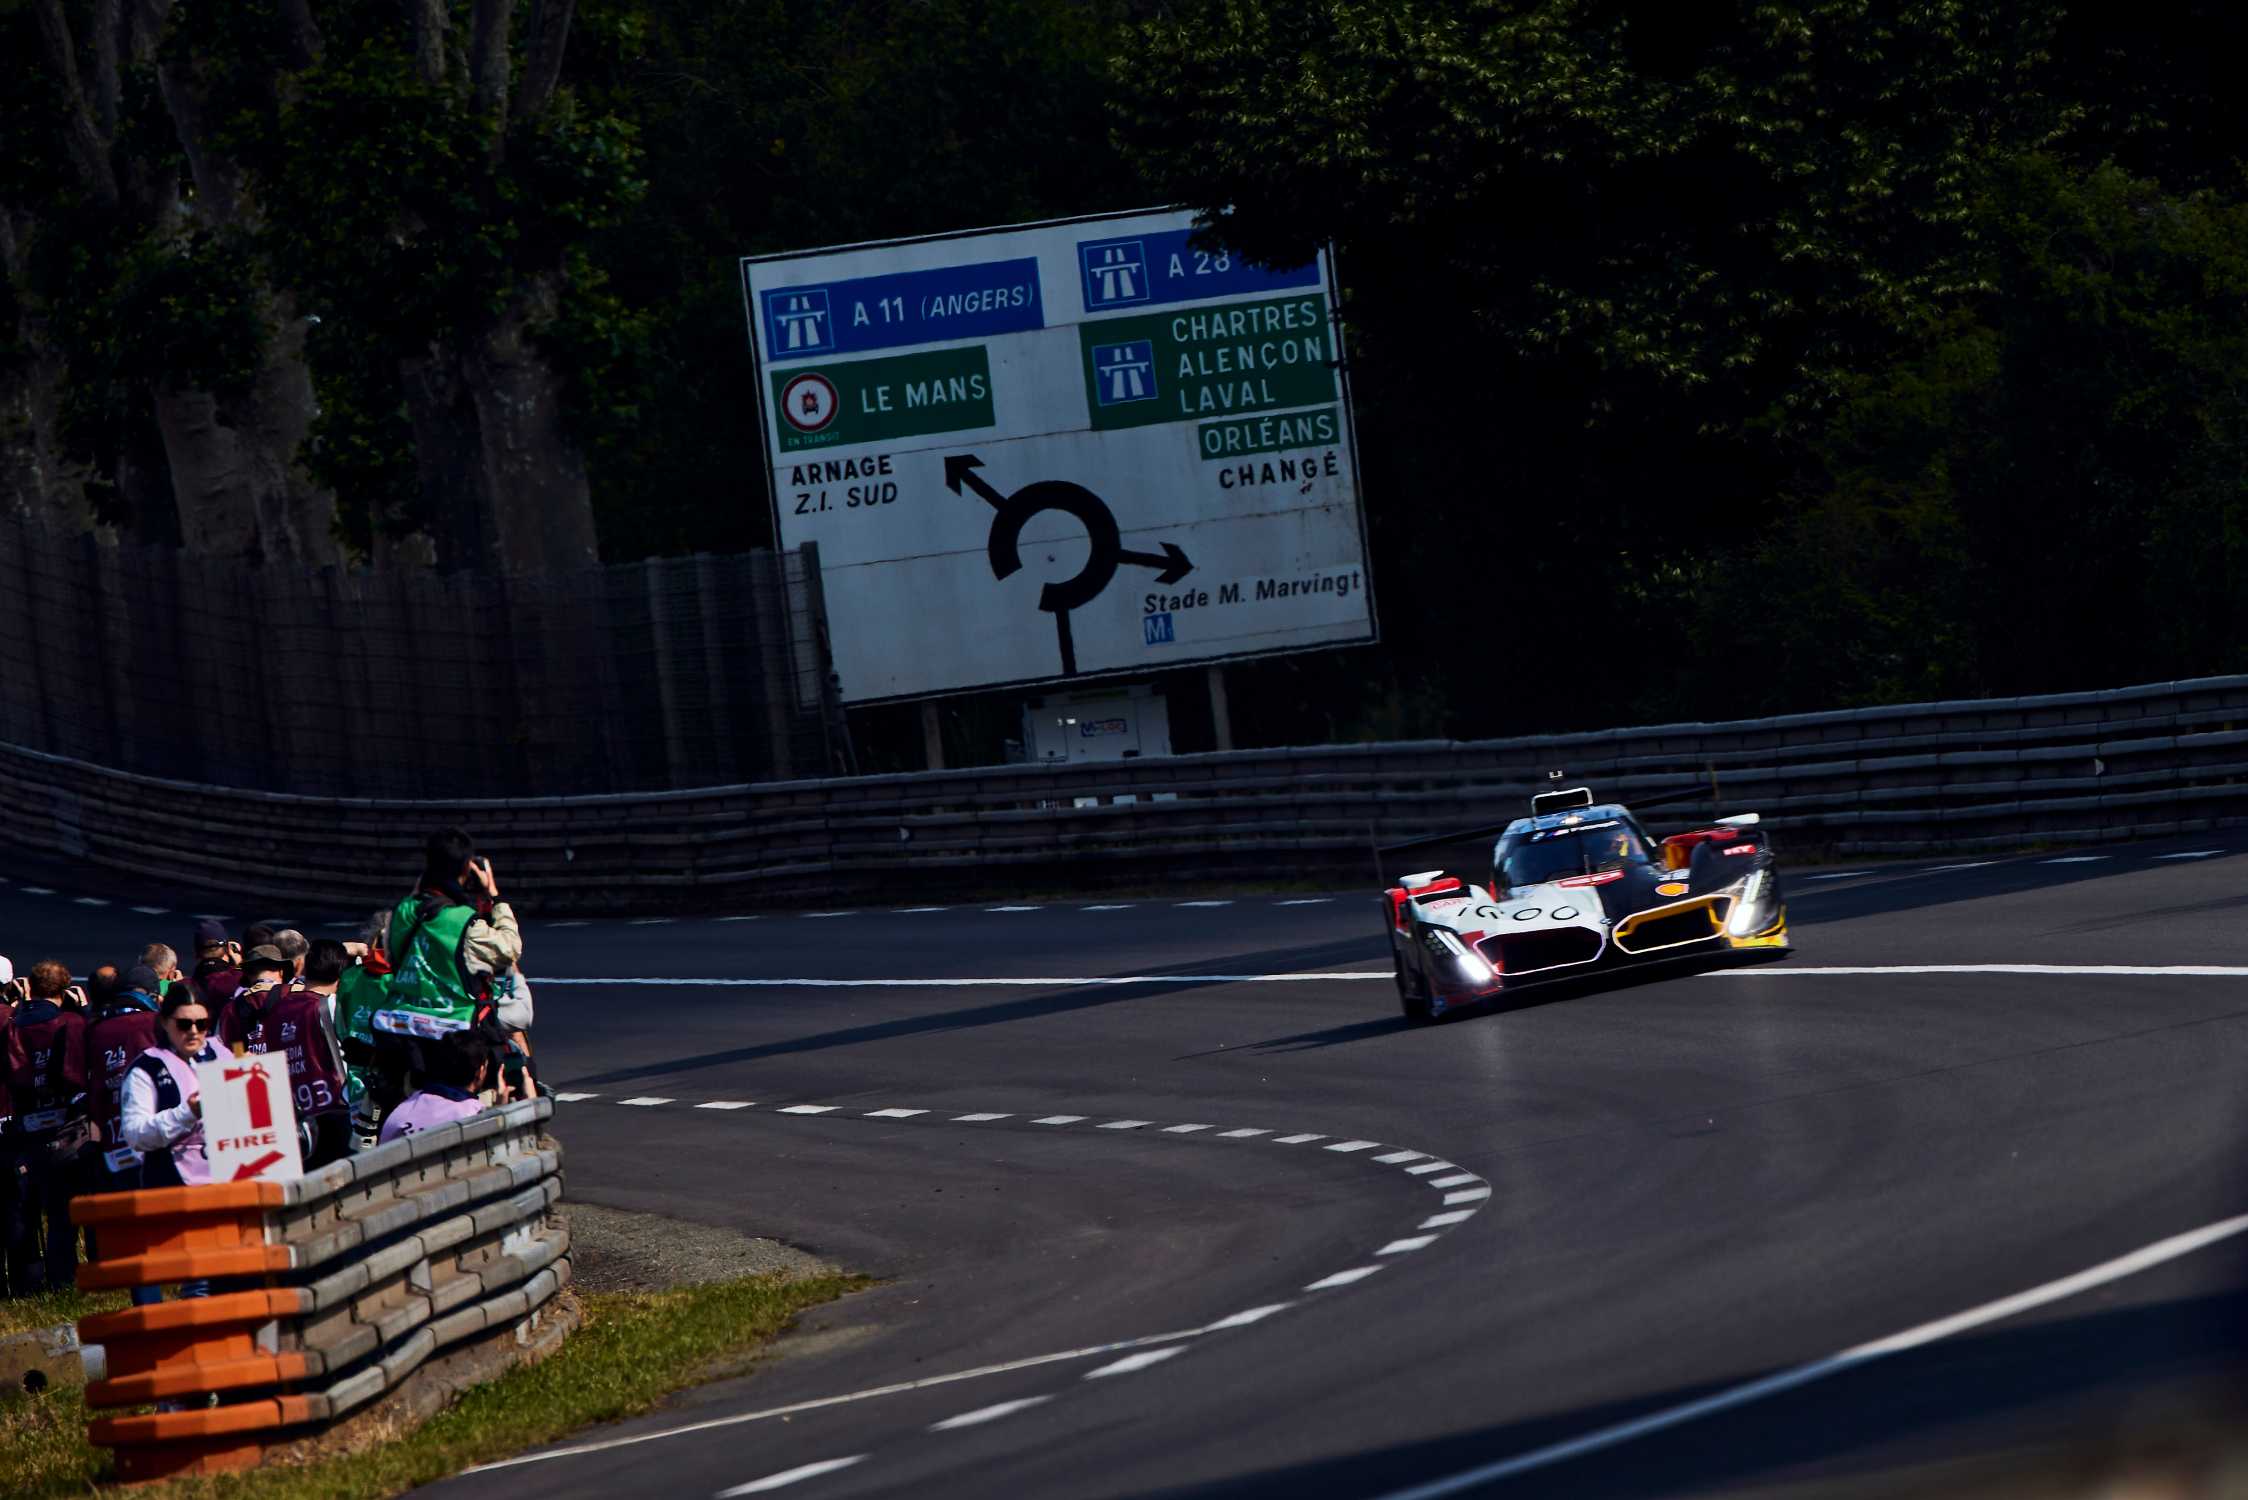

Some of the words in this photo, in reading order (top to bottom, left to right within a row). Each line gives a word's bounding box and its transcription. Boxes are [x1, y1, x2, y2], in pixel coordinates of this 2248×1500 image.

[1168, 253, 1185, 279] A
[853, 301, 870, 327] A
[879, 296, 905, 323] 11
[919, 283, 1034, 321] (ANGERS)
[1172, 301, 1317, 343] CHARTRES
[1178, 336, 1323, 379] ALENÇON
[860, 385, 893, 413] LE
[906, 374, 986, 409] MANS
[1180, 378, 1276, 414] LAVAL
[1204, 415, 1335, 454] ORLÉANS
[790, 454, 893, 487] ARNAGE
[1218, 450, 1340, 490] CHANGÉ
[794, 491, 833, 516] Z.I.
[845, 481, 898, 508] SUD
[1142, 587, 1209, 615] Stade
[1218, 583, 1246, 605] M.
[1255, 570, 1361, 601] Marvingt
[217, 1131, 278, 1152] FIRE
